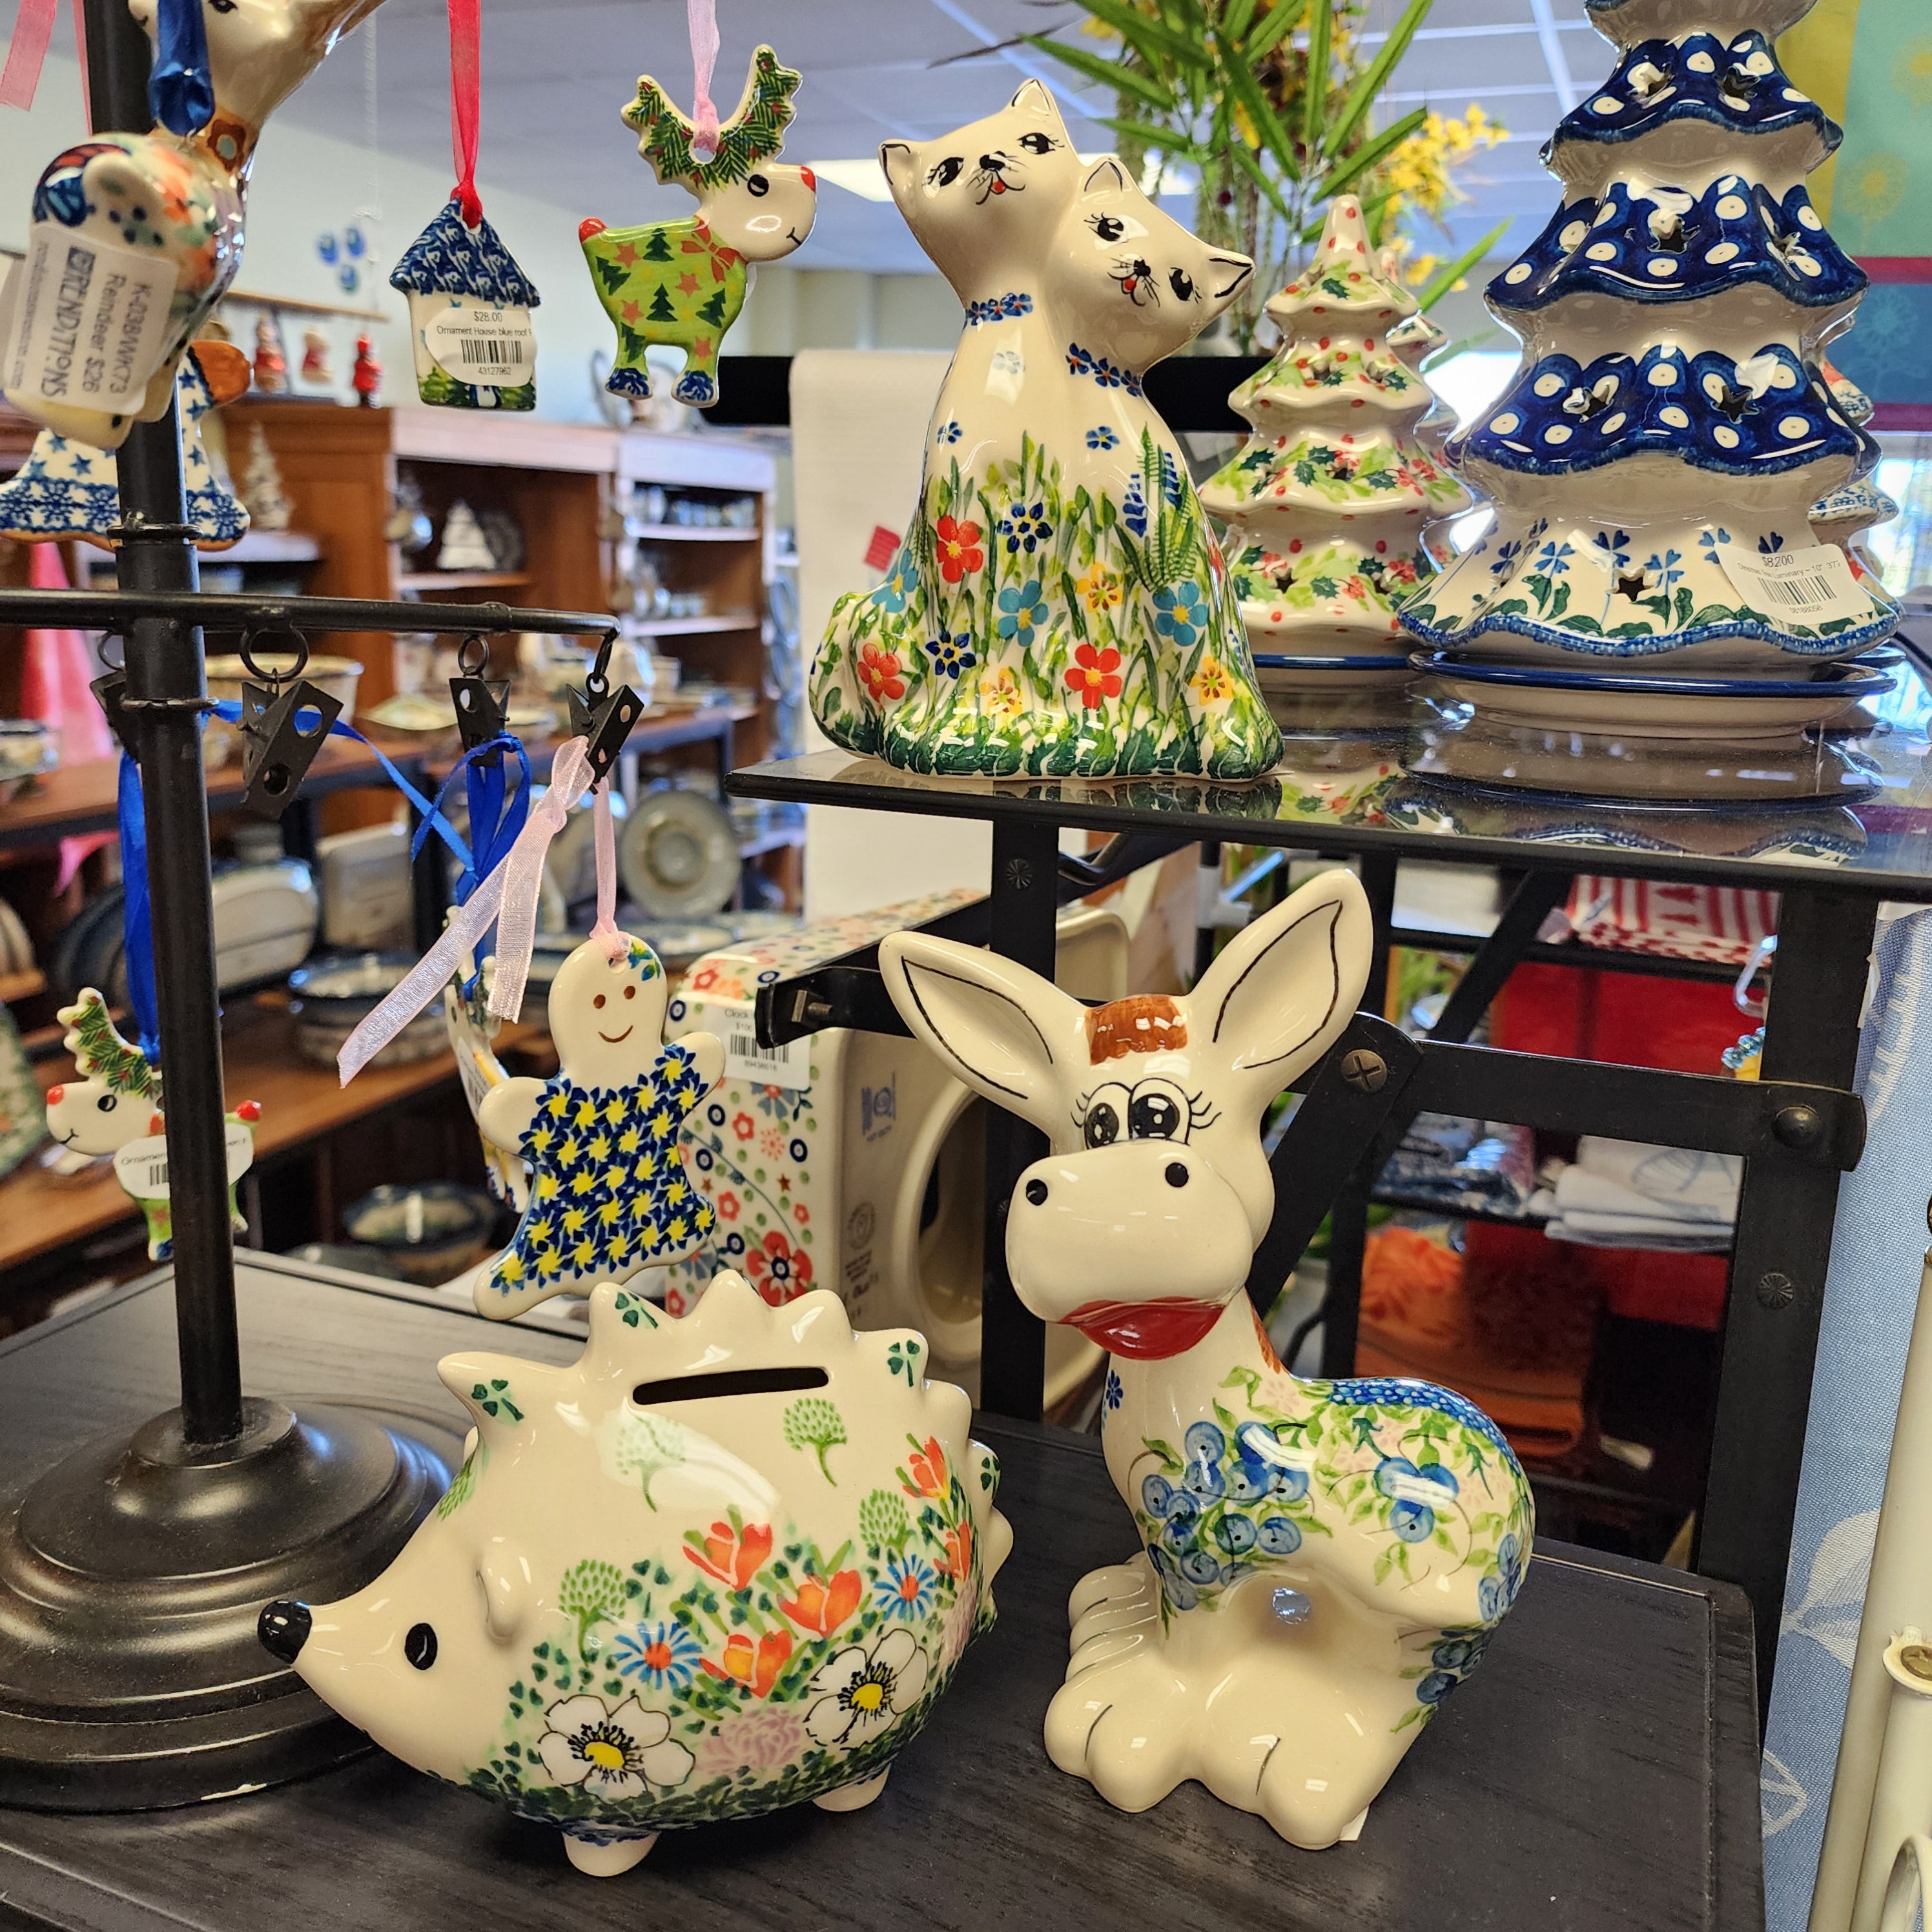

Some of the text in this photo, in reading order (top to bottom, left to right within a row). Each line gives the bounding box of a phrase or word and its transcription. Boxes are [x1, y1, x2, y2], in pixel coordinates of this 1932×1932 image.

[474, 311, 502, 322] $28.00
[437, 325, 472, 334] Ornament
[725, 1009, 749, 1018] Clock
[121, 1153, 167, 1165] Ornamen
